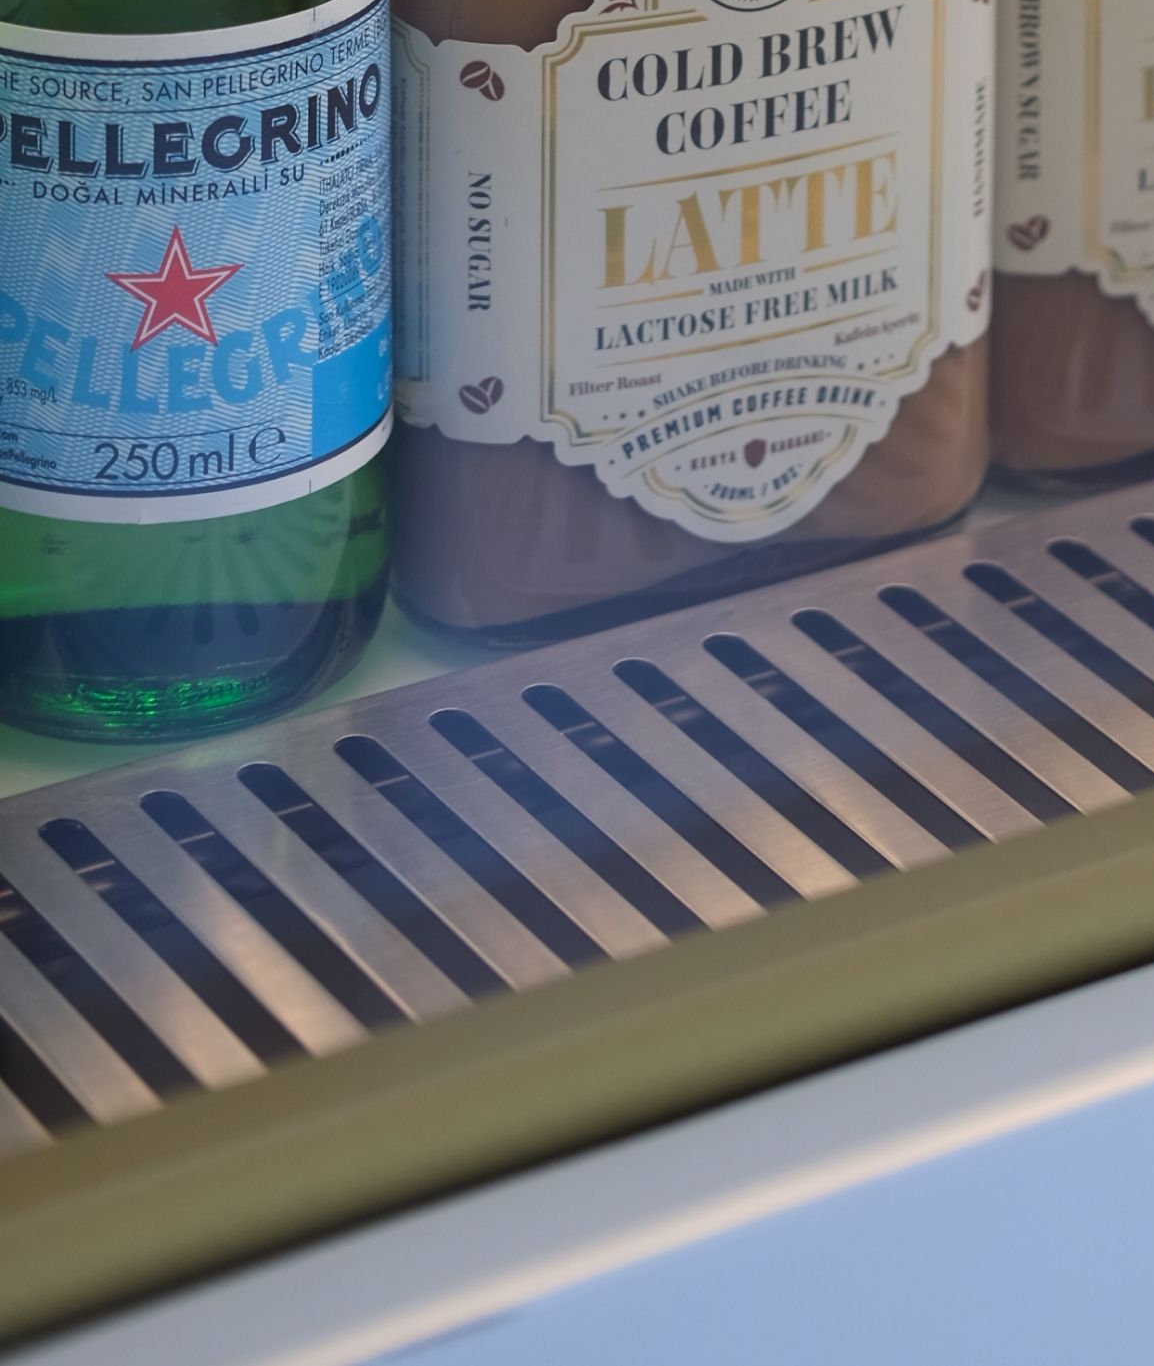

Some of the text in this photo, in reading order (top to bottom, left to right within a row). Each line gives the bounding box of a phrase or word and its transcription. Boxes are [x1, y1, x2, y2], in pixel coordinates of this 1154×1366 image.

[30, 75, 130, 105] SOURCE,
[142, 81, 192, 102] SAN
[203, 52, 324, 99] PELLEGRINO
[330, 26, 370, 66] TERME
[597, 5, 905, 102] COLD BREW
[0, 62, 382, 180] ELLEGRINO
[655, 78, 852, 156] COFFEE
[1018, 94, 1040, 181] SUGAR
[33, 180, 124, 206] DOĞAL
[280, 163, 305, 186] SU
[595, 149, 898, 290] LATTE
[467, 170, 492, 311] NO SUGAR
[594, 266, 899, 352] LACTOSE FREE MILK
[708, 267, 797, 297] MADE WITH
[568, 372, 663, 397] Filter Roast
[652, 354, 849, 409] SHAKE BEFORE DRINKING
[94, 441, 180, 481] 250
[189, 433, 235, 477] ml
[621, 385, 876, 460] PREMIUM COFFEE DRINK
